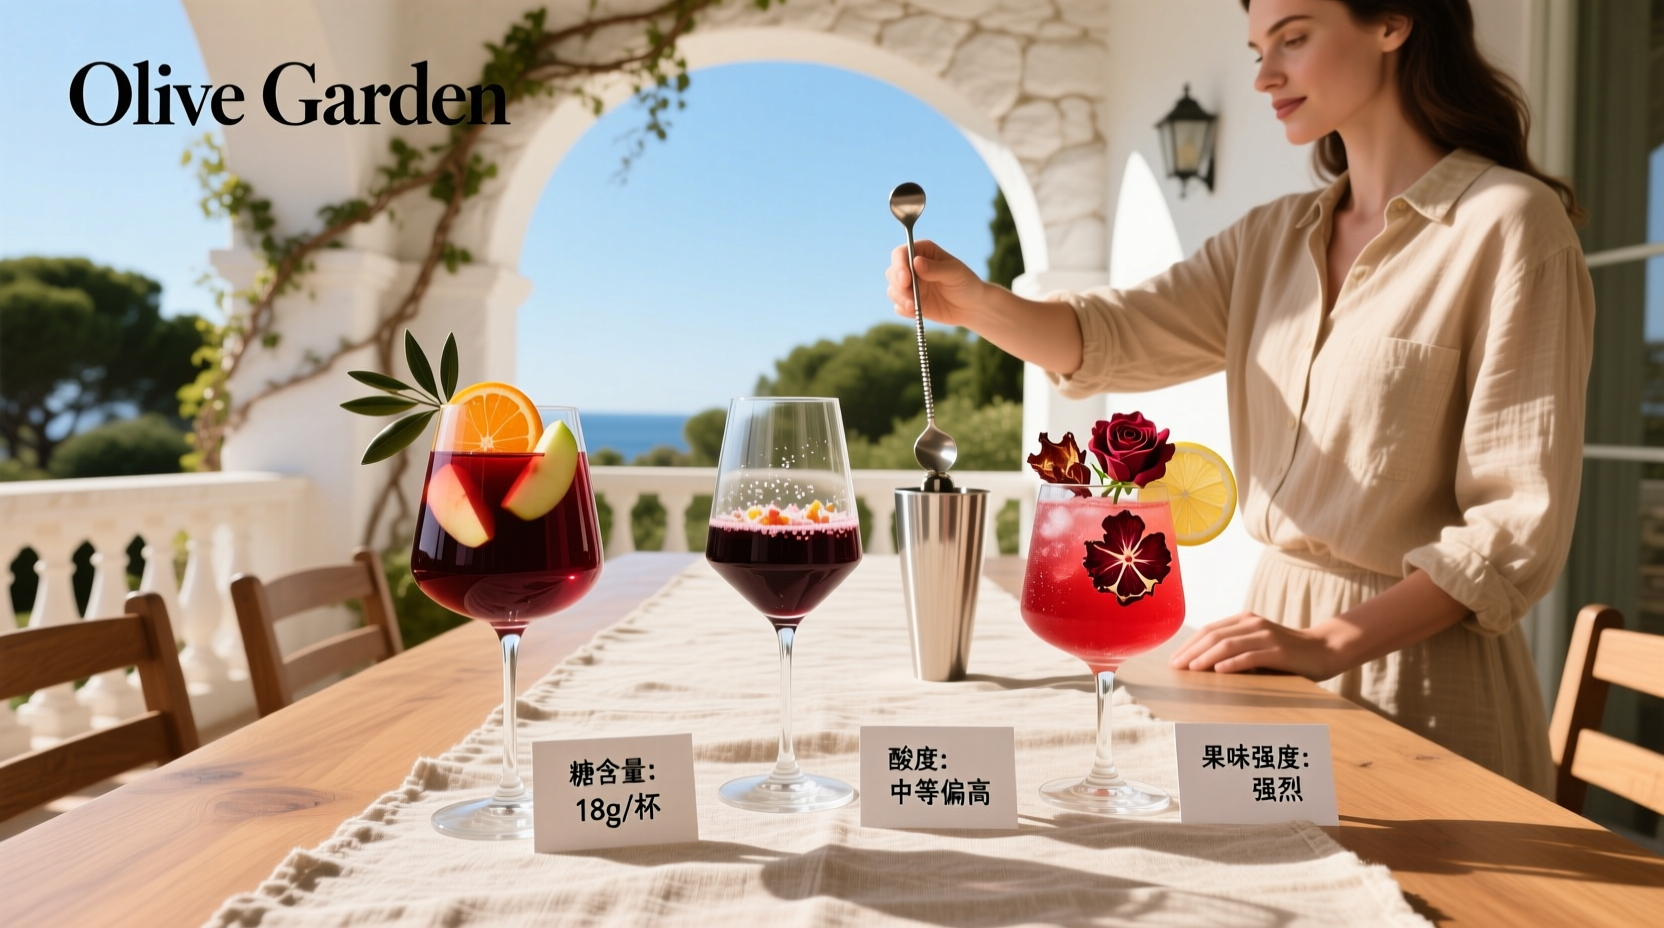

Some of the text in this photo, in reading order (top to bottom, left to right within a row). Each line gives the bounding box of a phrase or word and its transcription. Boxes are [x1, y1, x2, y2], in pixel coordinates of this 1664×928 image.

[888, 745, 948, 772] 酸度:
[1202, 743, 1310, 770] 果味强度:
[890, 777, 991, 806] 中等偏高
[1252, 775, 1304, 803] 强烈
[576, 793, 662, 829] 18g/杯
